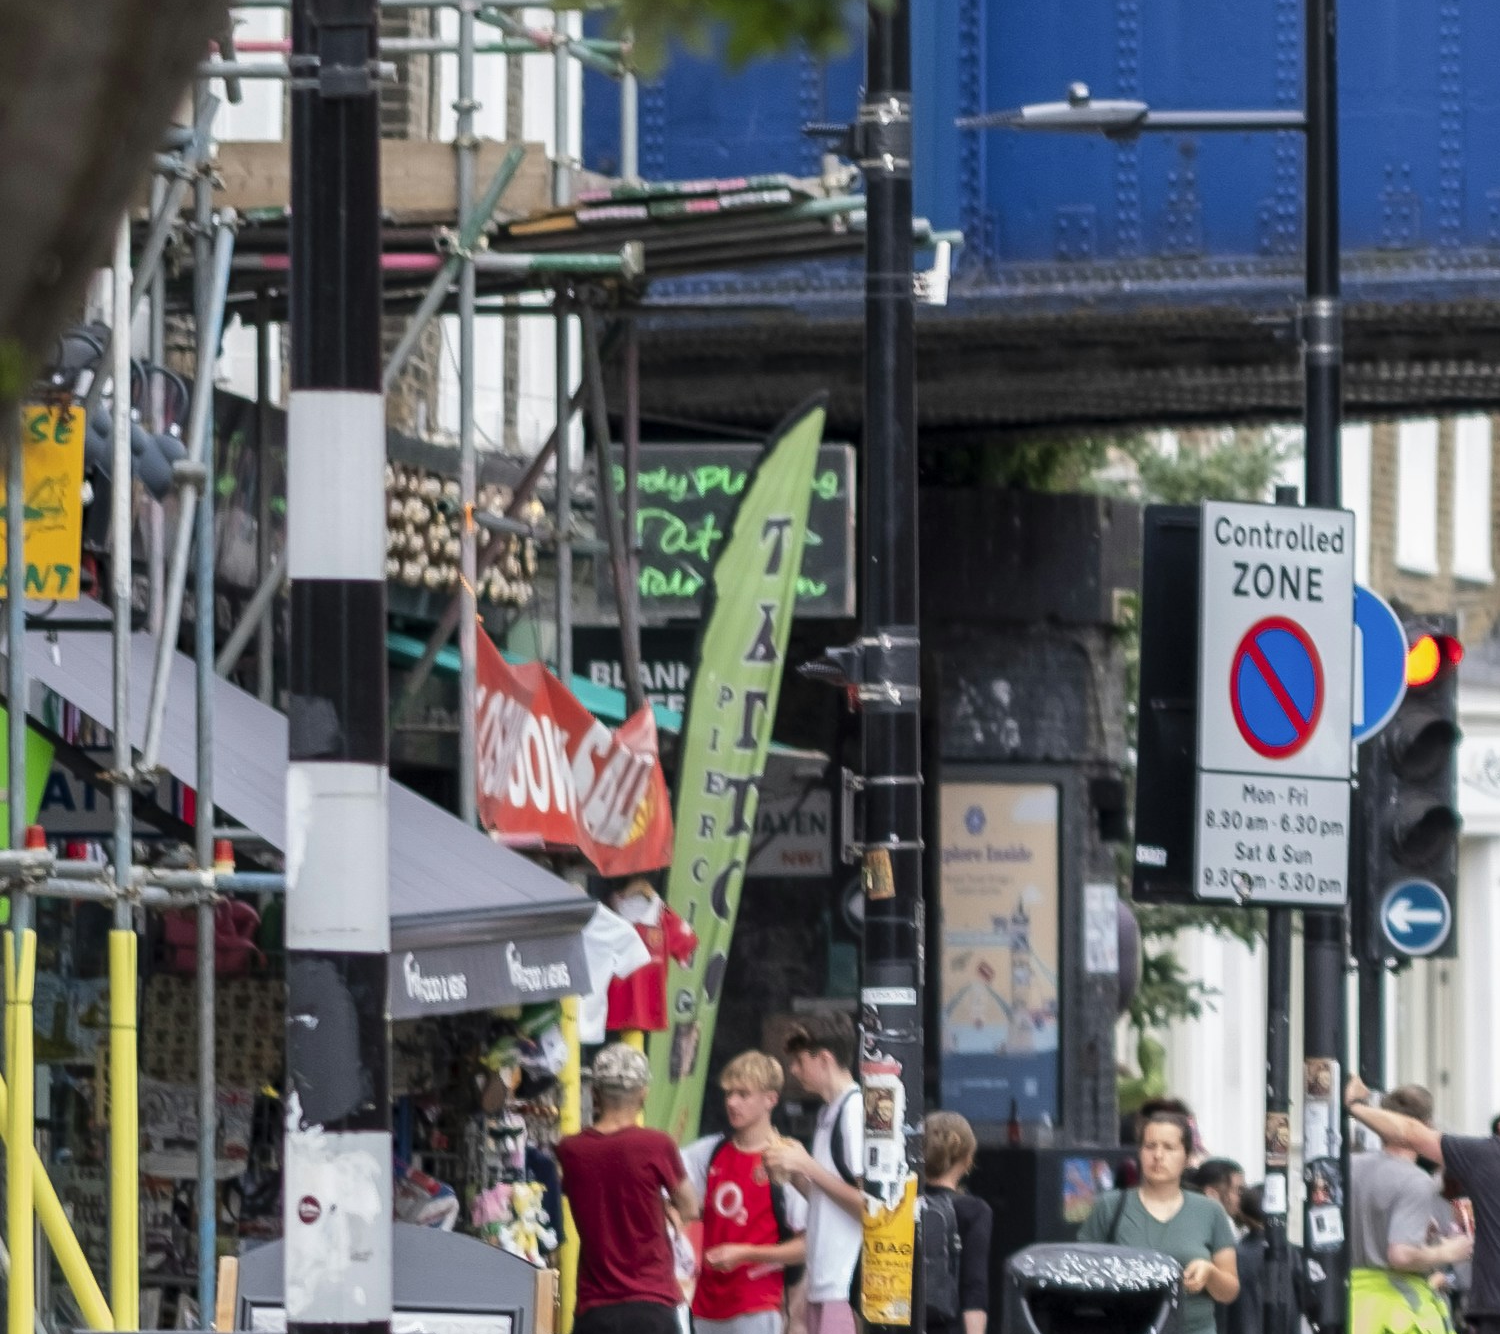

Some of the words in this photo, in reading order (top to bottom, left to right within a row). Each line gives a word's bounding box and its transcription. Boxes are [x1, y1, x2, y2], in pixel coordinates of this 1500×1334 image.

[1215, 516, 1344, 553] Controlled
[1233, 560, 1323, 602] ZONE
[1242, 783, 1276, 805] Mon
[1288, 786, 1308, 807] Fri
[1206, 809, 1243, 830] 8.30
[1246, 815, 1269, 832] am
[1280, 813, 1317, 835] 6.30
[1320, 819, 1345, 838] pm
[678, 684, 735, 1015] PIERCIG
[1235, 841, 1262, 862] Sat
[1266, 843, 1277, 863] &
[1282, 844, 1313, 865] Sun
[1279, 872, 1315, 892] 5.30
[1318, 878, 1343, 896] pm
